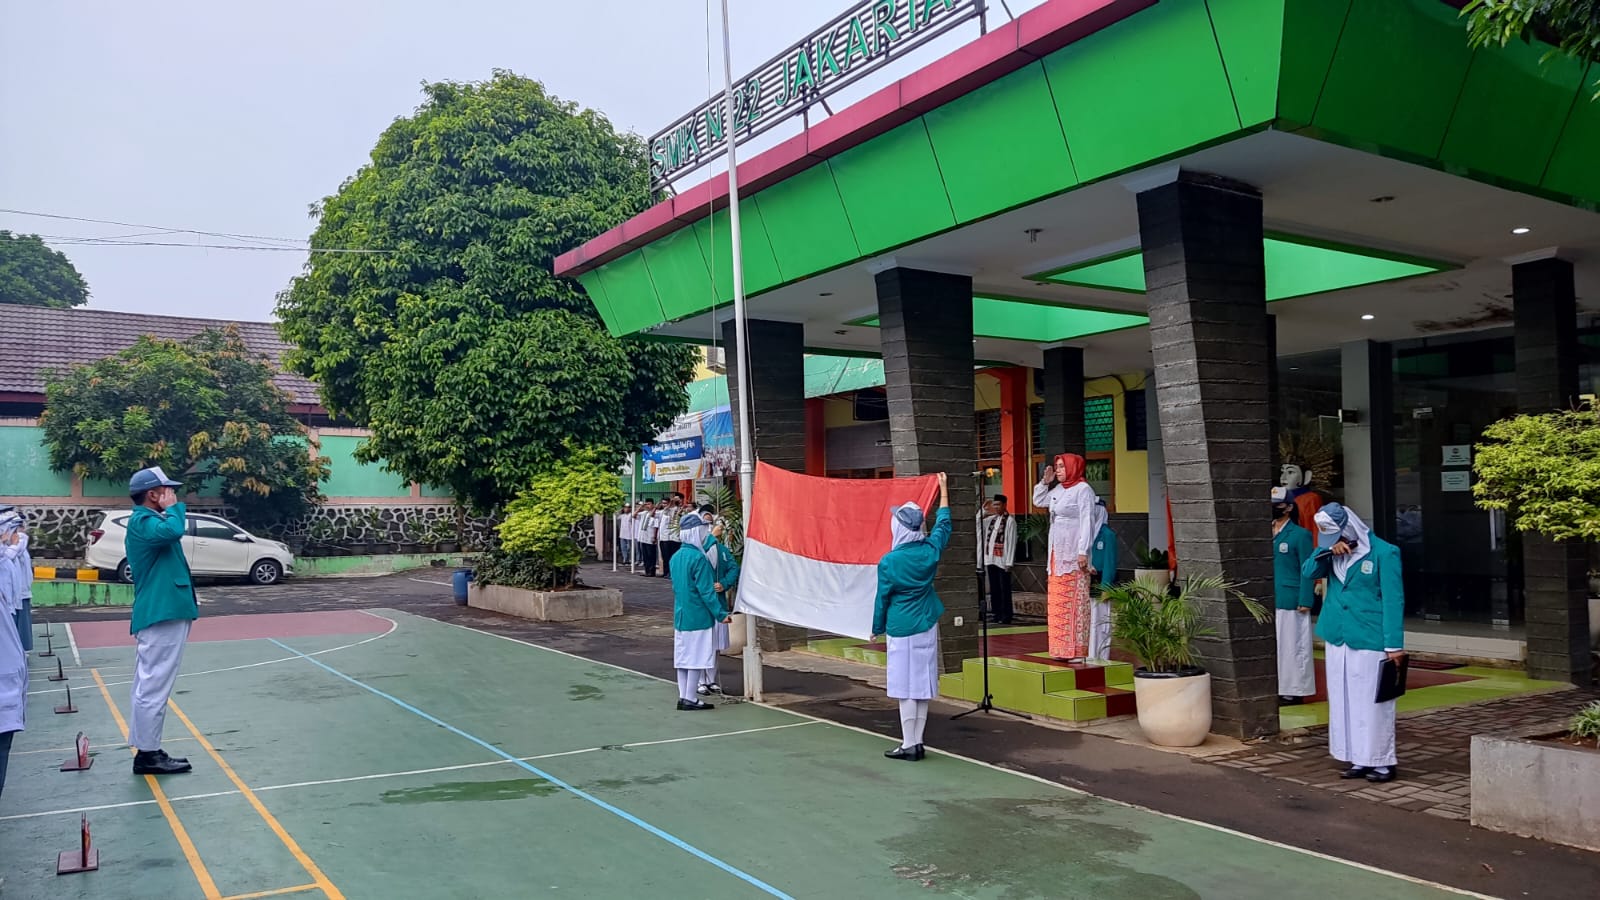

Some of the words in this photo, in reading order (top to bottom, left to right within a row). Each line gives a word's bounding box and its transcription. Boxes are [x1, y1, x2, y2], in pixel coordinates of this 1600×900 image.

[651, 114, 700, 177] SMK
[704, 101, 723, 148] N
[733, 77, 762, 133] 22
